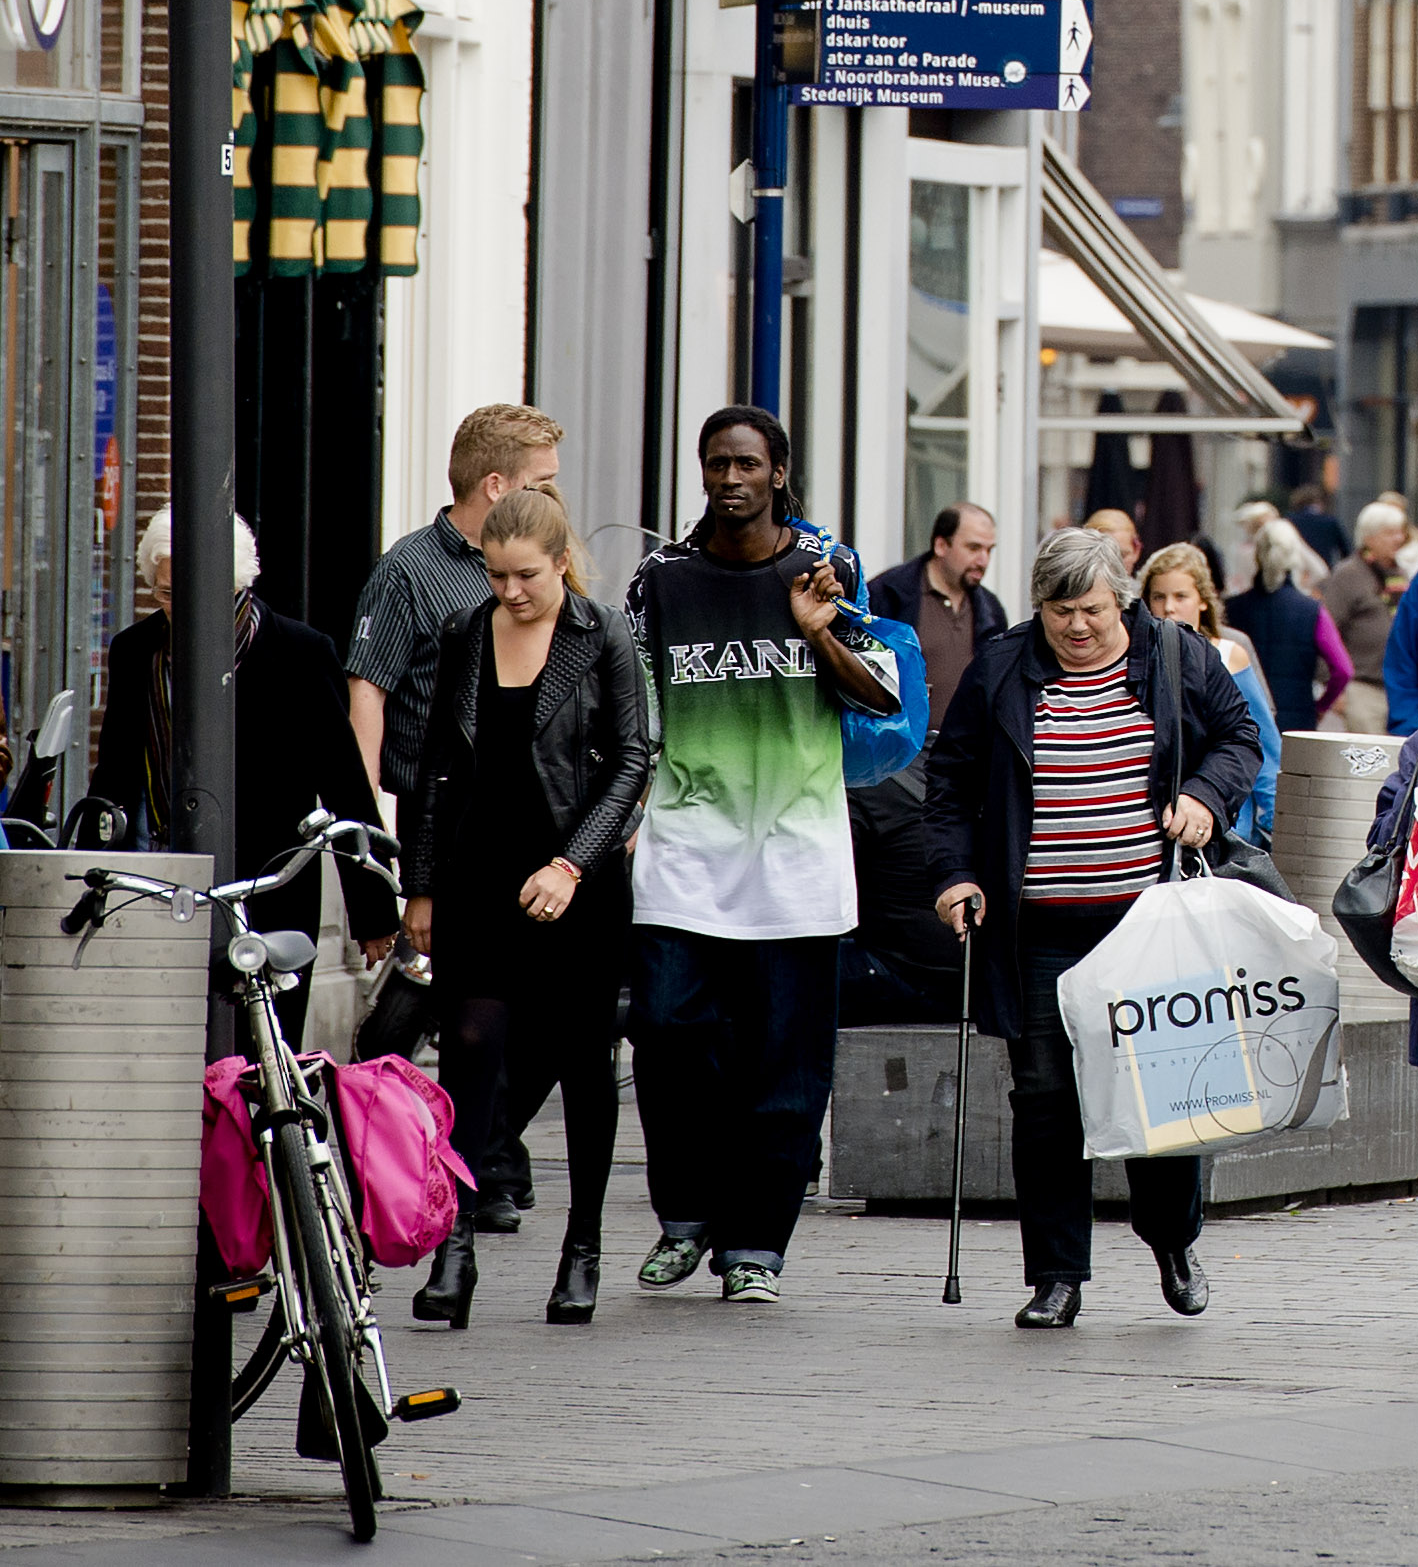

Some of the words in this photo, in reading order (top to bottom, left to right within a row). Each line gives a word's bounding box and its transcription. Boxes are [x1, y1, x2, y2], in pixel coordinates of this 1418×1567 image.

[960, 0, 968, 17] /
[971, 1, 1045, 16] -museum
[826, 14, 870, 29] dhuis
[827, 52, 861, 65] ater
[865, 53, 894, 66] aan
[898, 52, 918, 67] de
[922, 52, 977, 69] Parade
[834, 69, 954, 87] Noordbrabants
[958, 72, 1006, 87] Muse
[801, 86, 873, 106] Stedelijk
[876, 88, 944, 104] Museum
[224, 148, 232, 171] 5
[1107, 967, 1306, 1048] promiss
[1113, 1059, 1158, 1075] JOUW
[1169, 1089, 1273, 1113] WWW.PROMISS.NL
